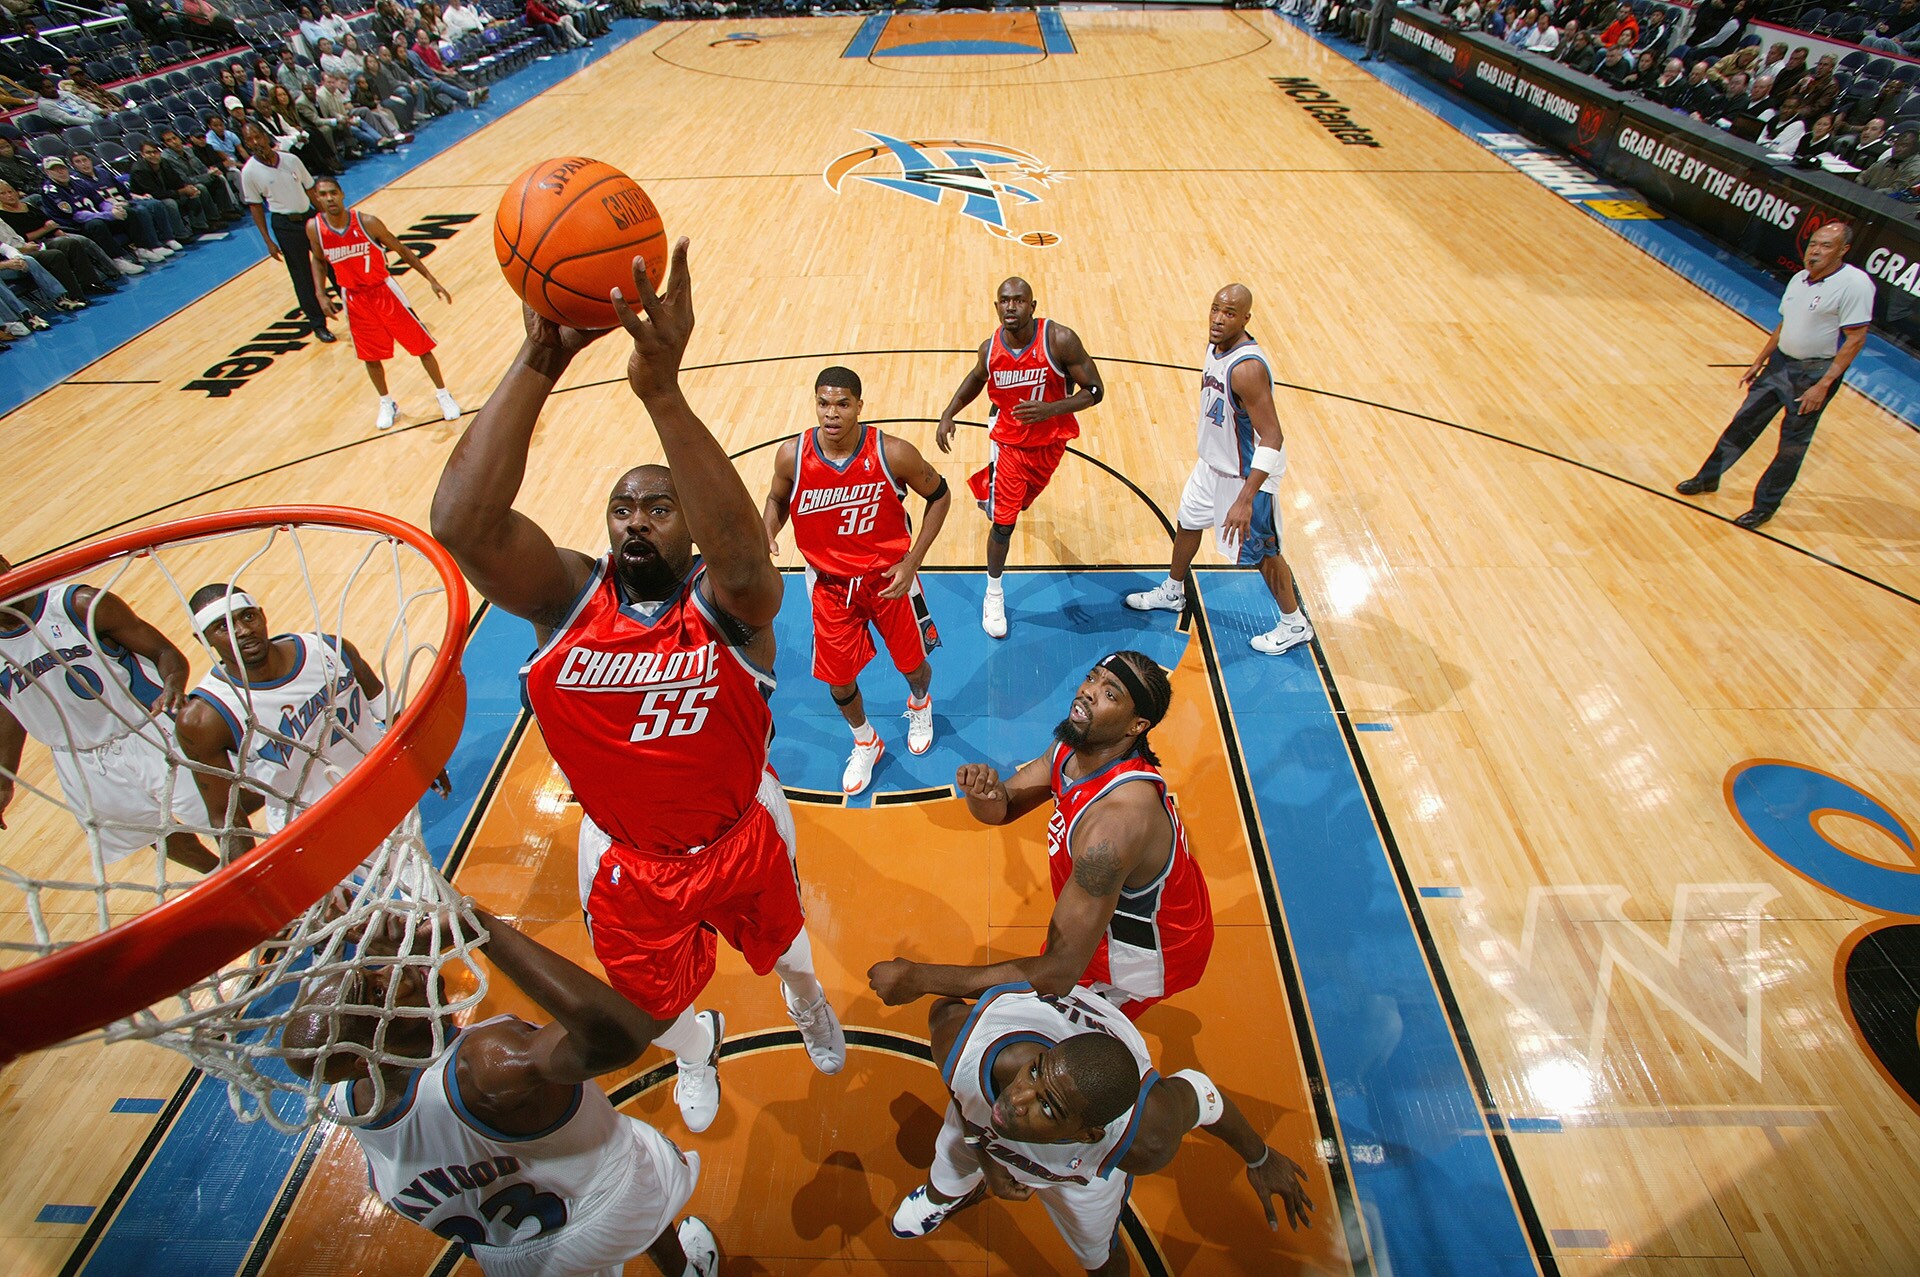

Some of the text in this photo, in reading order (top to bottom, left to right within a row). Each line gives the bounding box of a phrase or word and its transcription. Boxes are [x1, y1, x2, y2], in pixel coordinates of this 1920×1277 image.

[1268, 77, 1340, 103] MCI
[1476, 61, 1500, 85] GRAB
[1496, 70, 1517, 93] LIFE
[1514, 78, 1530, 99] BY
[1527, 84, 1547, 108] THE
[1543, 91, 1580, 124] HORNS
[1302, 105, 1384, 148] Center
[1618, 127, 1657, 157] GRAB
[1652, 143, 1684, 175] LIFE
[1679, 156, 1707, 184] BY
[1701, 167, 1737, 200] THE
[1730, 182, 1801, 230] HORNS
[363, 255, 370, 273] 1
[993, 367, 1049, 388] CHARLOTTE
[797, 481, 886, 515] CHARLOTTE
[838, 503, 879, 535] 32
[65, 664, 104, 700] 0
[555, 640, 720, 690] CHARLOTTE
[629, 685, 720, 743] 55
[391, 1155, 521, 1223] AYWOOD
